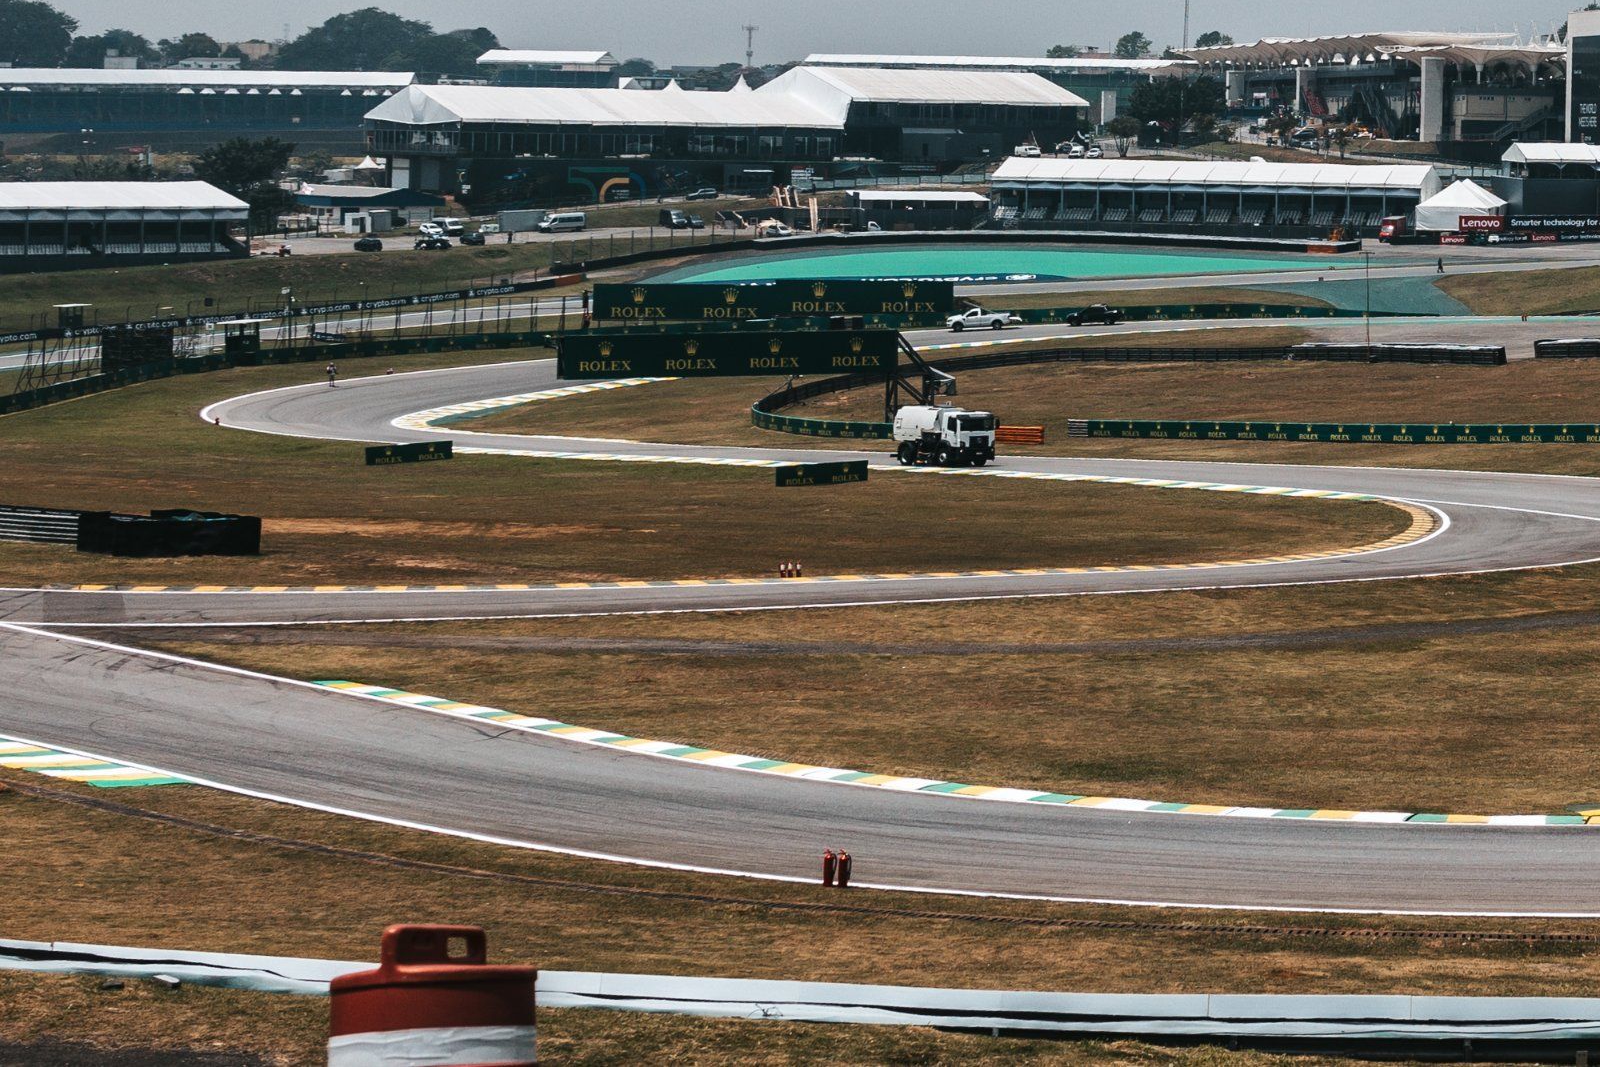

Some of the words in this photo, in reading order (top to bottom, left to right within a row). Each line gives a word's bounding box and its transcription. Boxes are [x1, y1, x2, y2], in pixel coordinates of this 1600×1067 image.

[1462, 218, 1500, 227] Lenovo
[1543, 218, 1585, 227] technology
[1587, 218, 1598, 226] for
[421, 293, 460, 303] crypto.com
[792, 301, 845, 312] ROLEX
[882, 302, 935, 313] ROLEX
[611, 307, 666, 318] ROLEX
[703, 307, 758, 318] ROLEX
[666, 358, 716, 370] ROLEX
[750, 357, 799, 368] ROLEX
[832, 356, 880, 366] ROLEX
[579, 361, 631, 372] ROLEX
[375, 456, 402, 464] ROLEX
[419, 452, 445, 461] ROLEX
[786, 477, 814, 485] ROLEX
[832, 474, 860, 482] ROLEX
